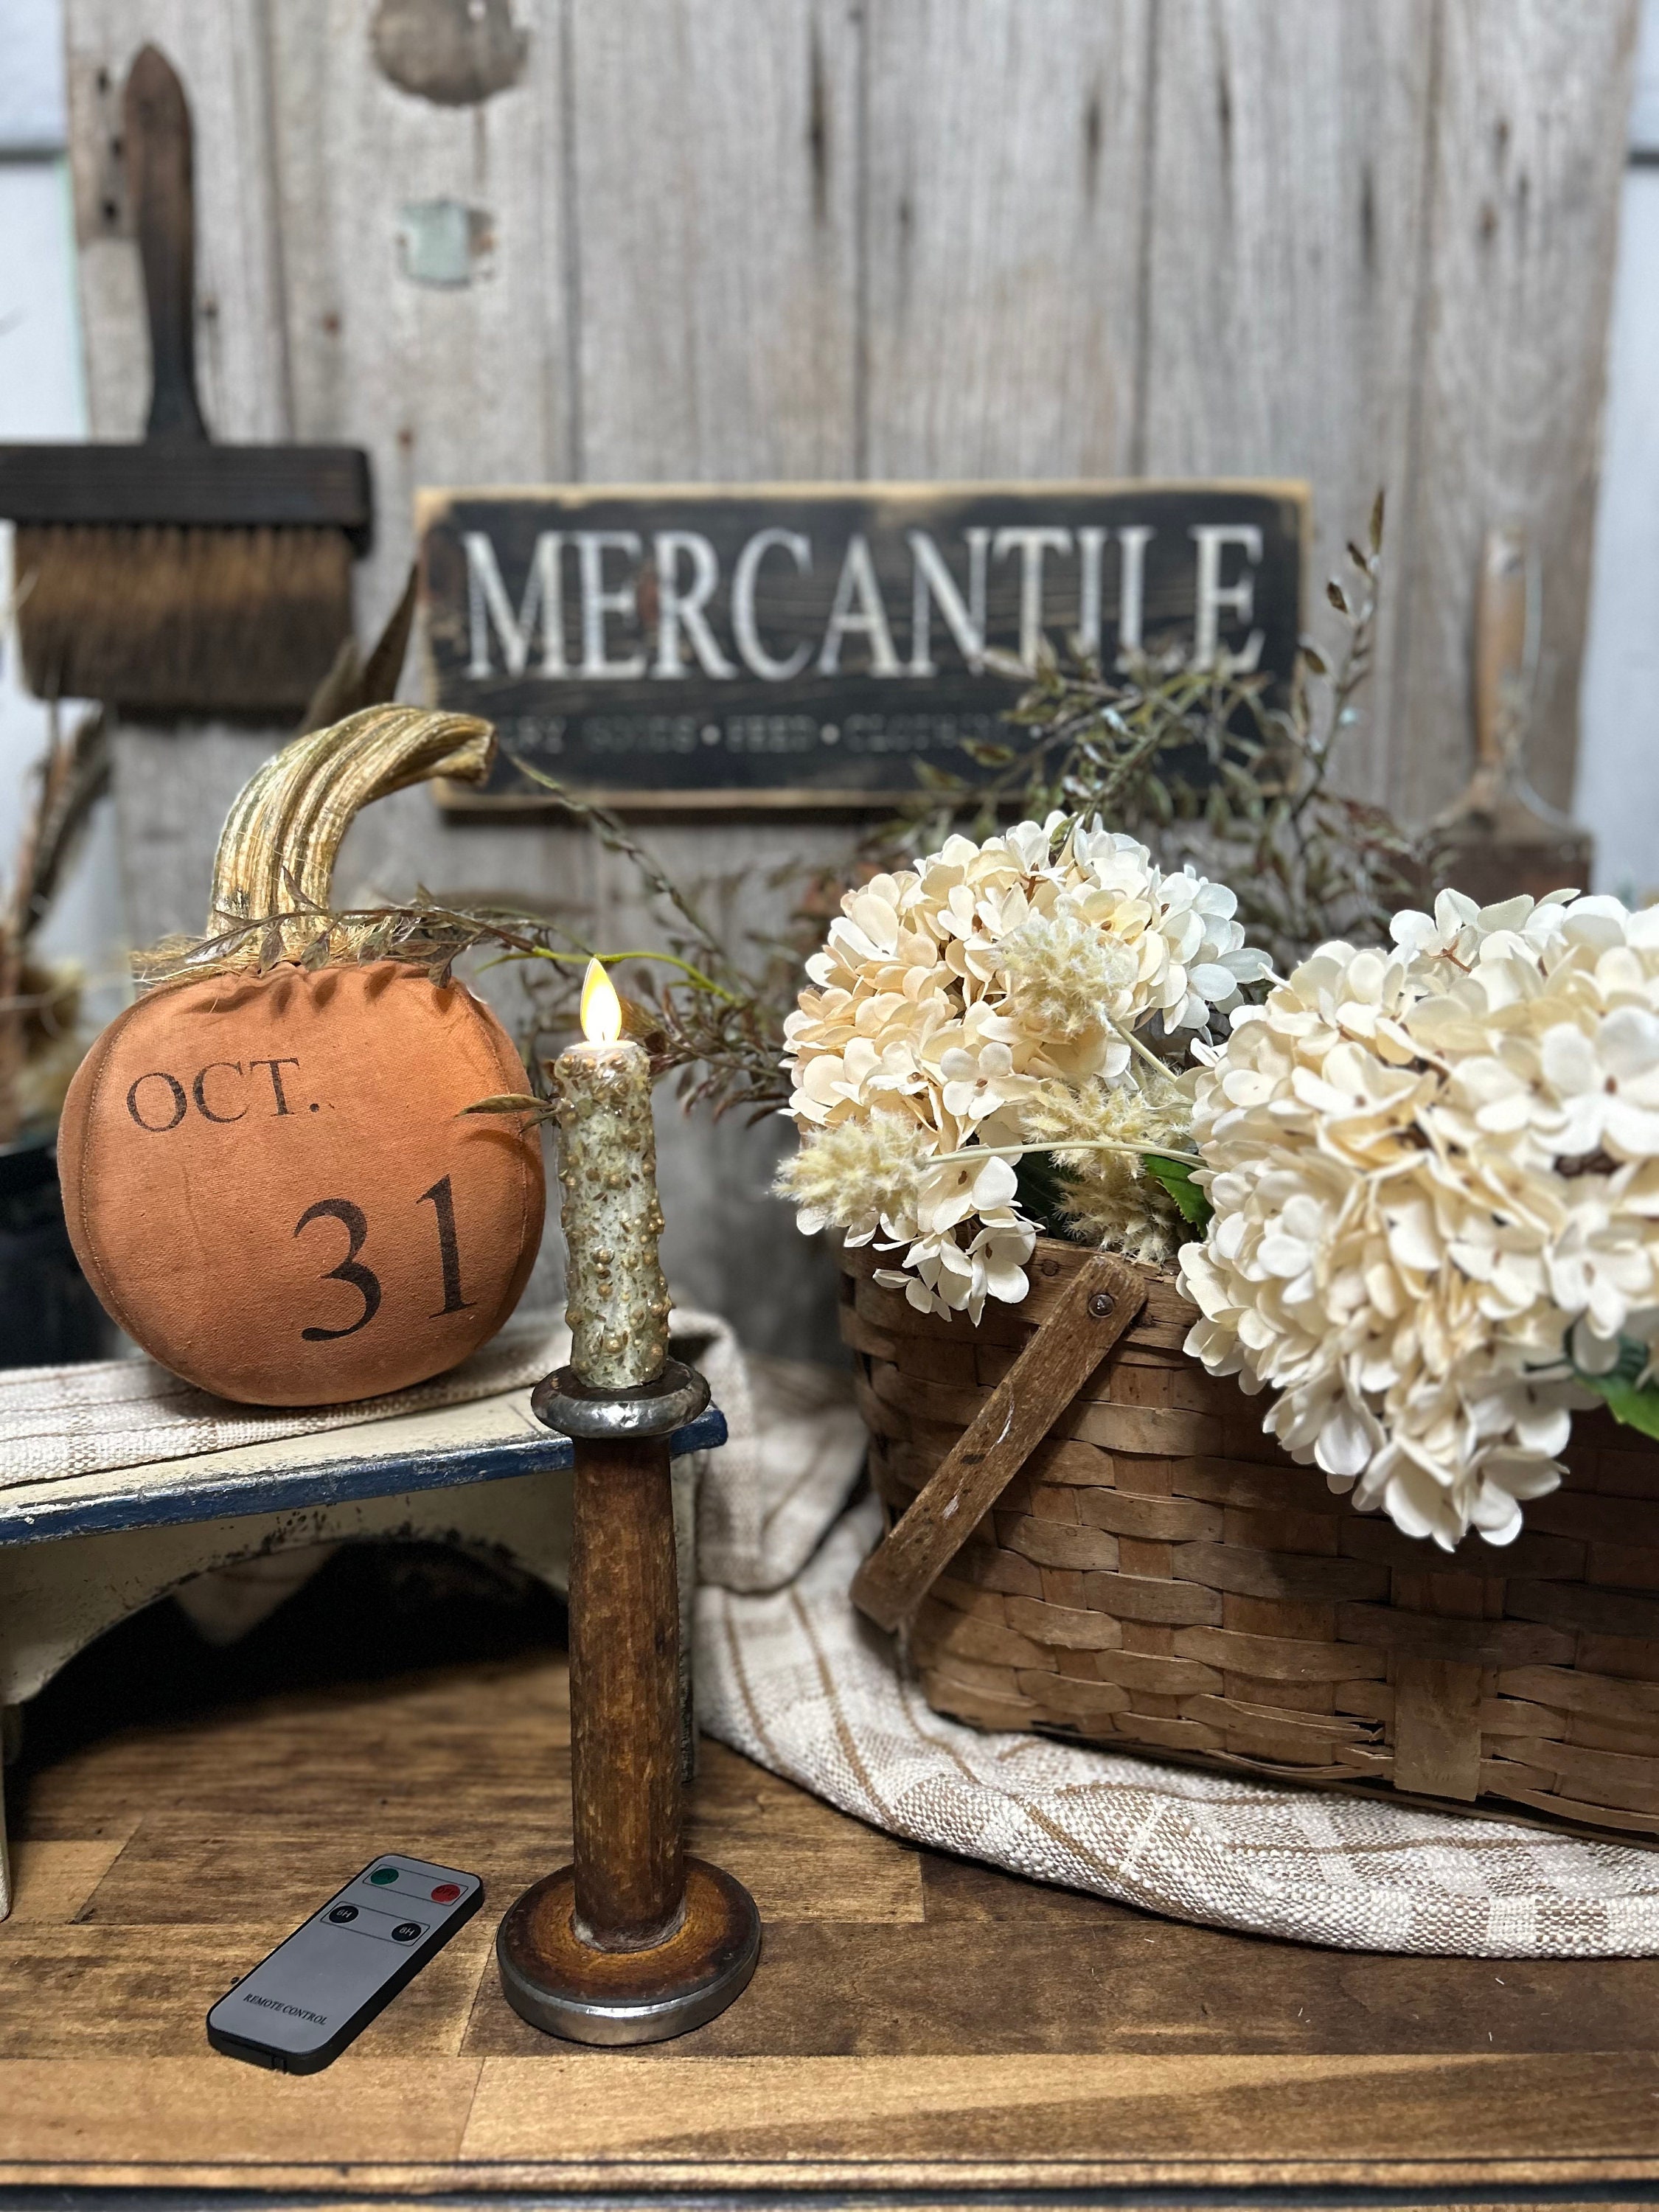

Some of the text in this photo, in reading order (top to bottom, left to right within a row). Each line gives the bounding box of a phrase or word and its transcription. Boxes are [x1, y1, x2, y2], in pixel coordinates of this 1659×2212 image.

[461, 524, 1265, 681] MERCANTILE
[126, 1057, 321, 1133] OCT.
[293, 1173, 478, 1342] 31
[436, 1885, 456, 1897] OFF
[336, 1908, 414, 1937] 6H 8H
[243, 1992, 327, 2025] REMOTE CONTROL
